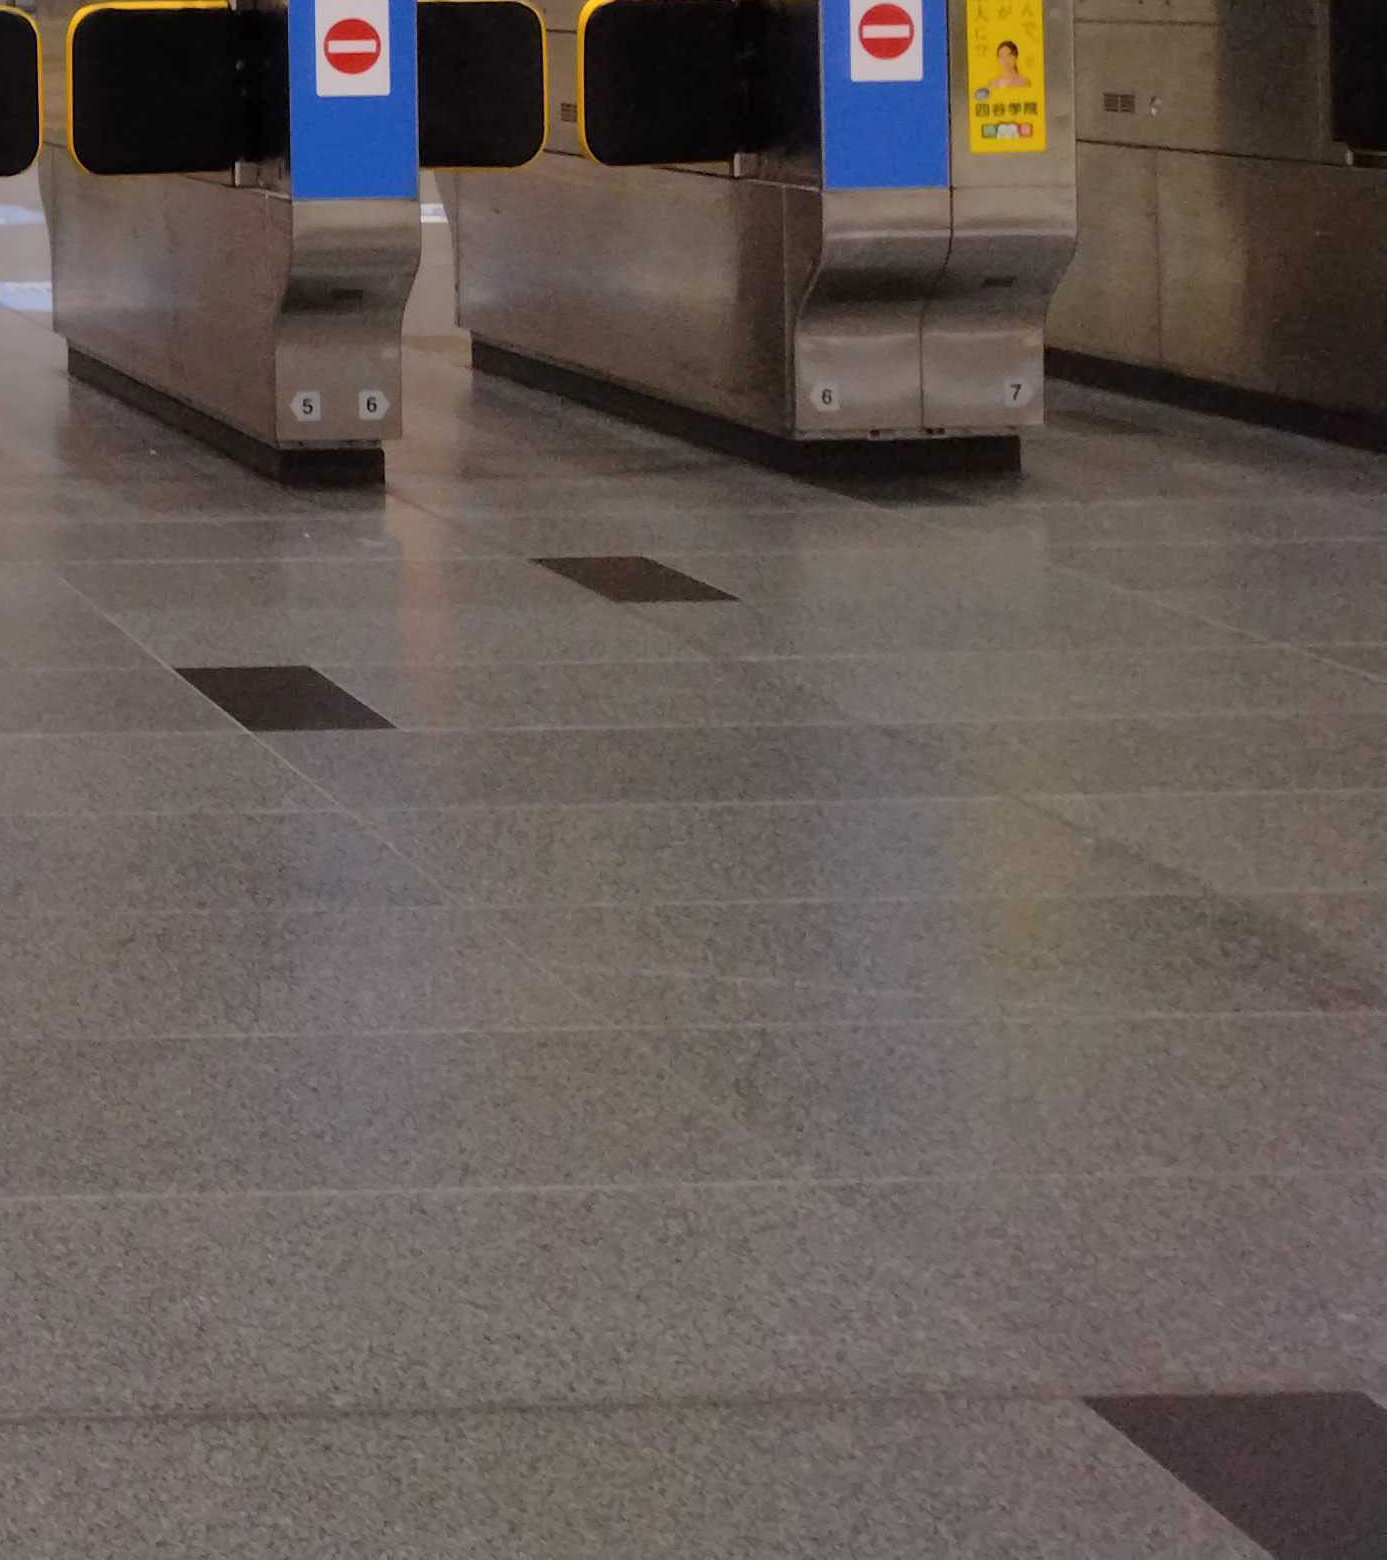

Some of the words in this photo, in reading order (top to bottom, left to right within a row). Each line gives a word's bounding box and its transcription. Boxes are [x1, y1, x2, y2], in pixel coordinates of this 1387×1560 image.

[821, 388, 832, 405] 6
[1010, 384, 1021, 401] 7
[302, 399, 313, 415] 5
[366, 396, 377, 413] 6
